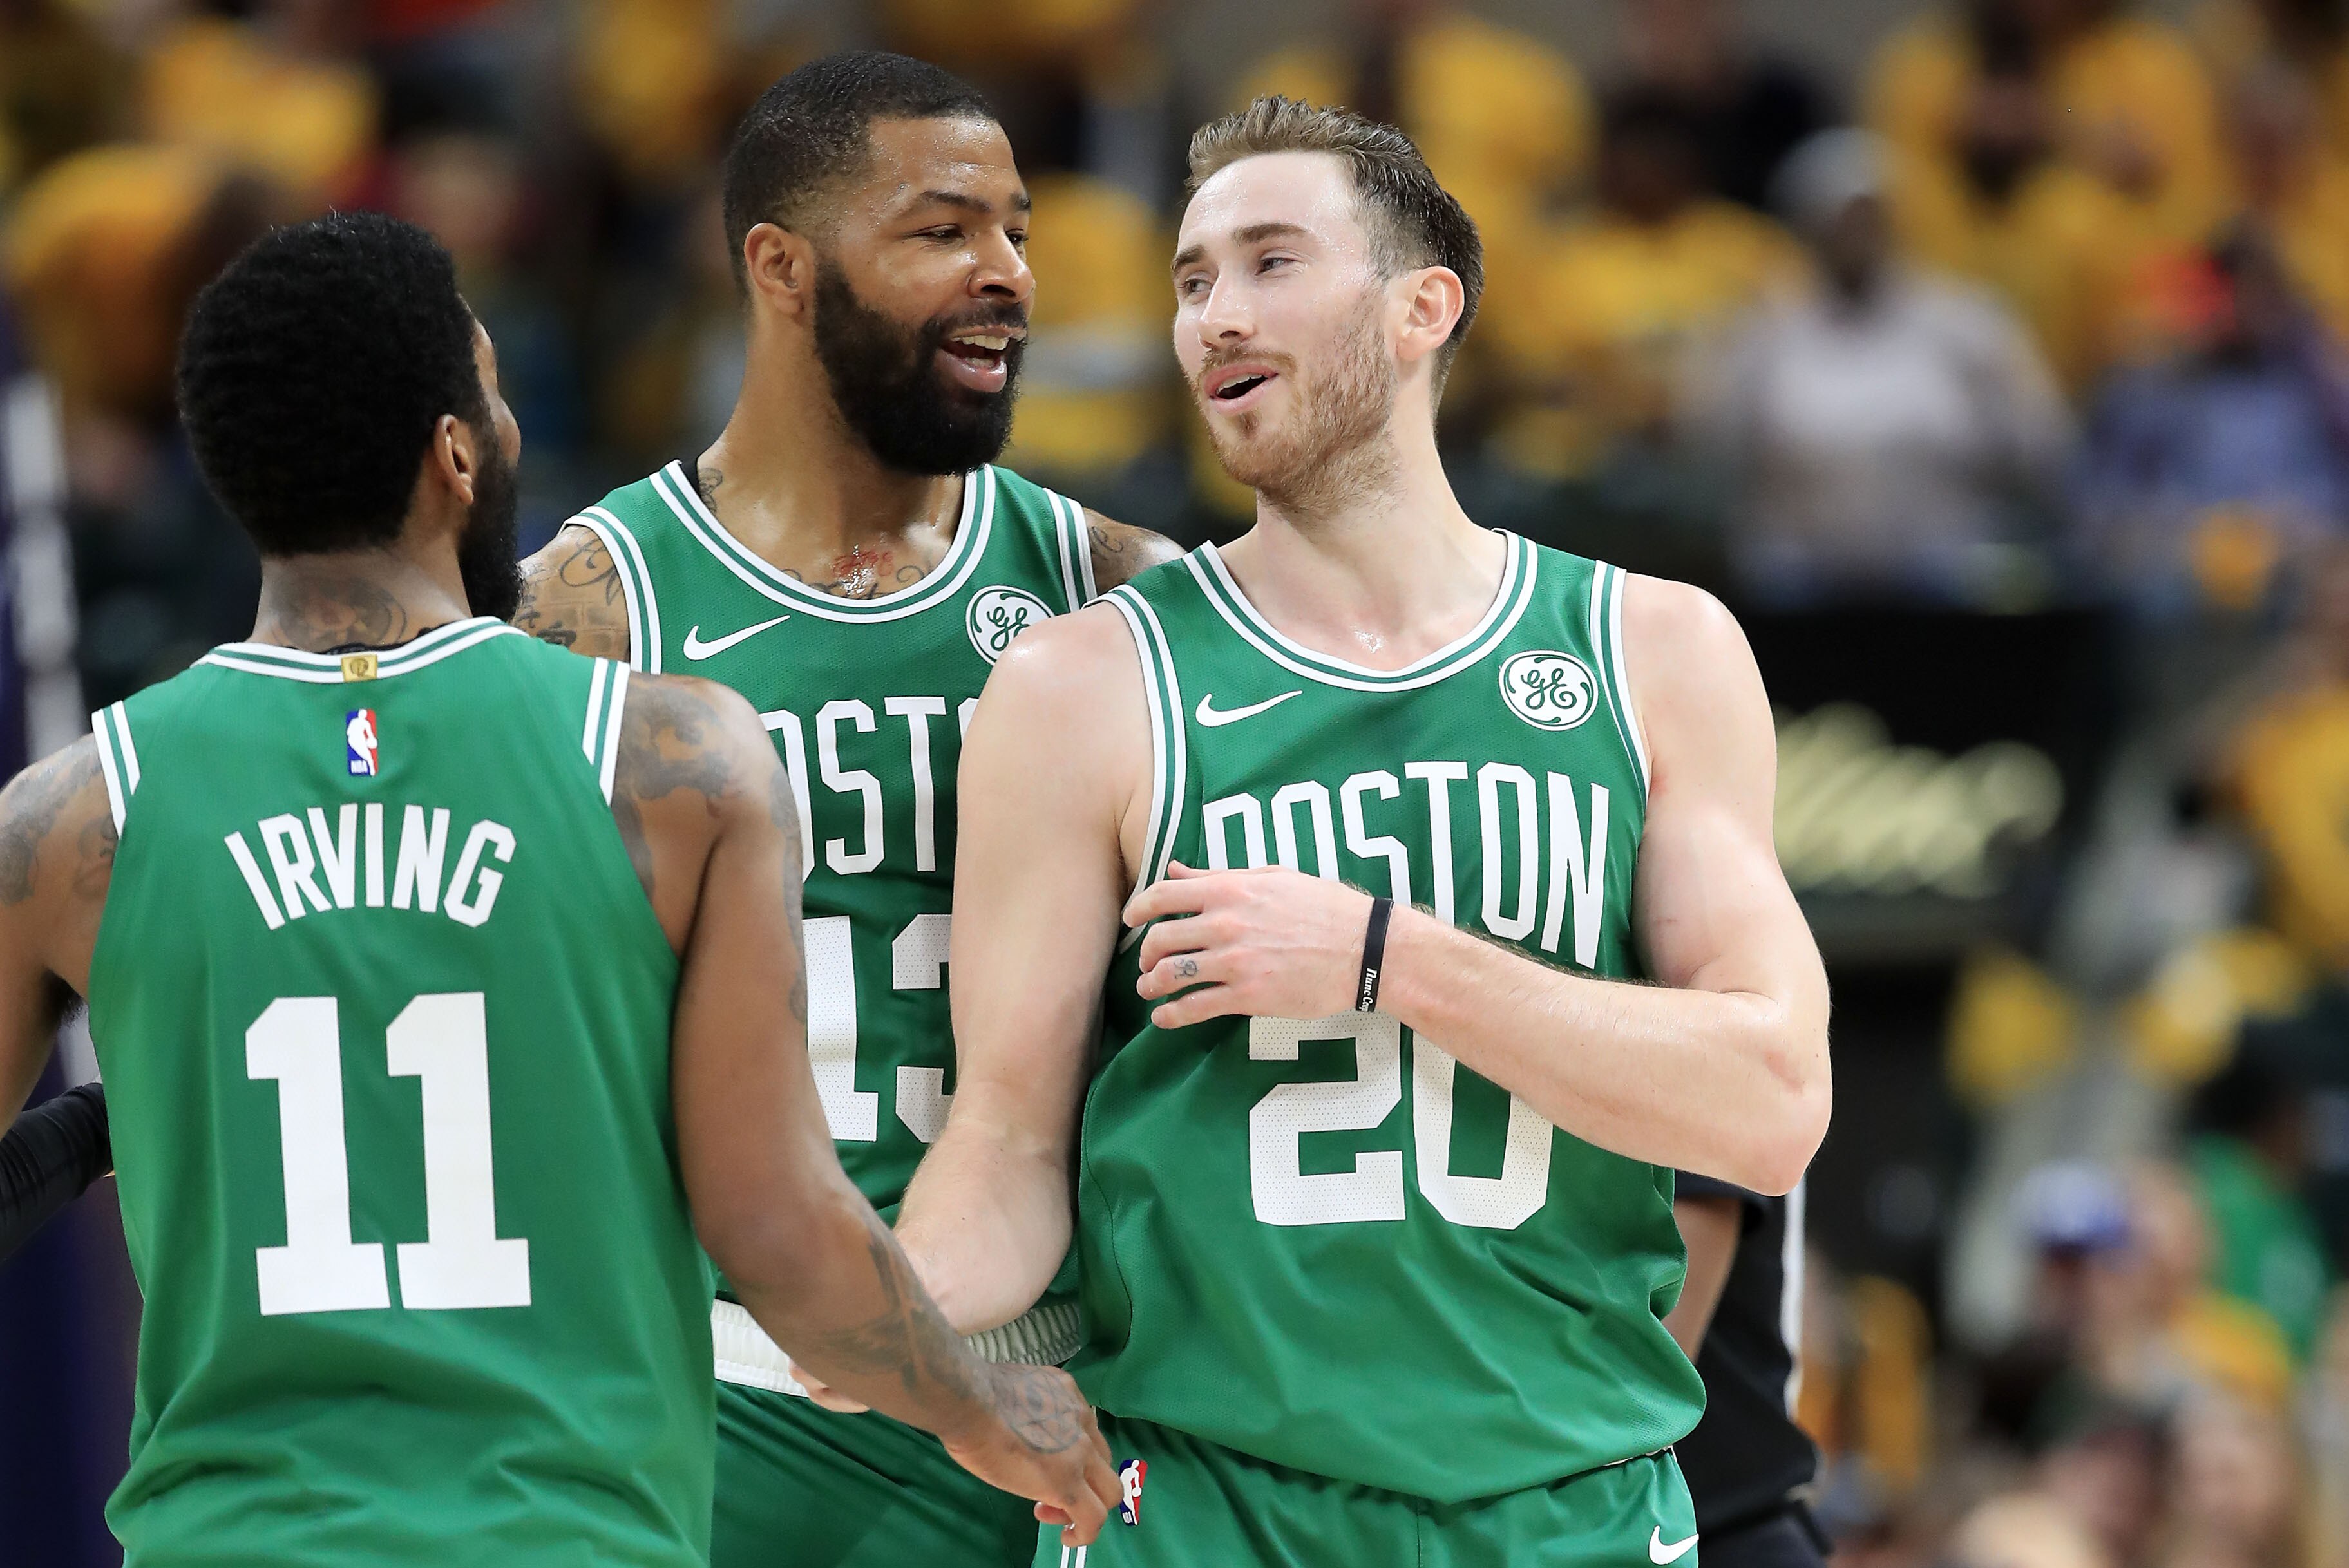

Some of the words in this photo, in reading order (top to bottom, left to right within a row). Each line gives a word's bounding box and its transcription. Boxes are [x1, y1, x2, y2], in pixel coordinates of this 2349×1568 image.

[224, 802, 517, 930] IRVING
[245, 992, 531, 1316] 11
[1249, 1010, 1554, 1231] 20
